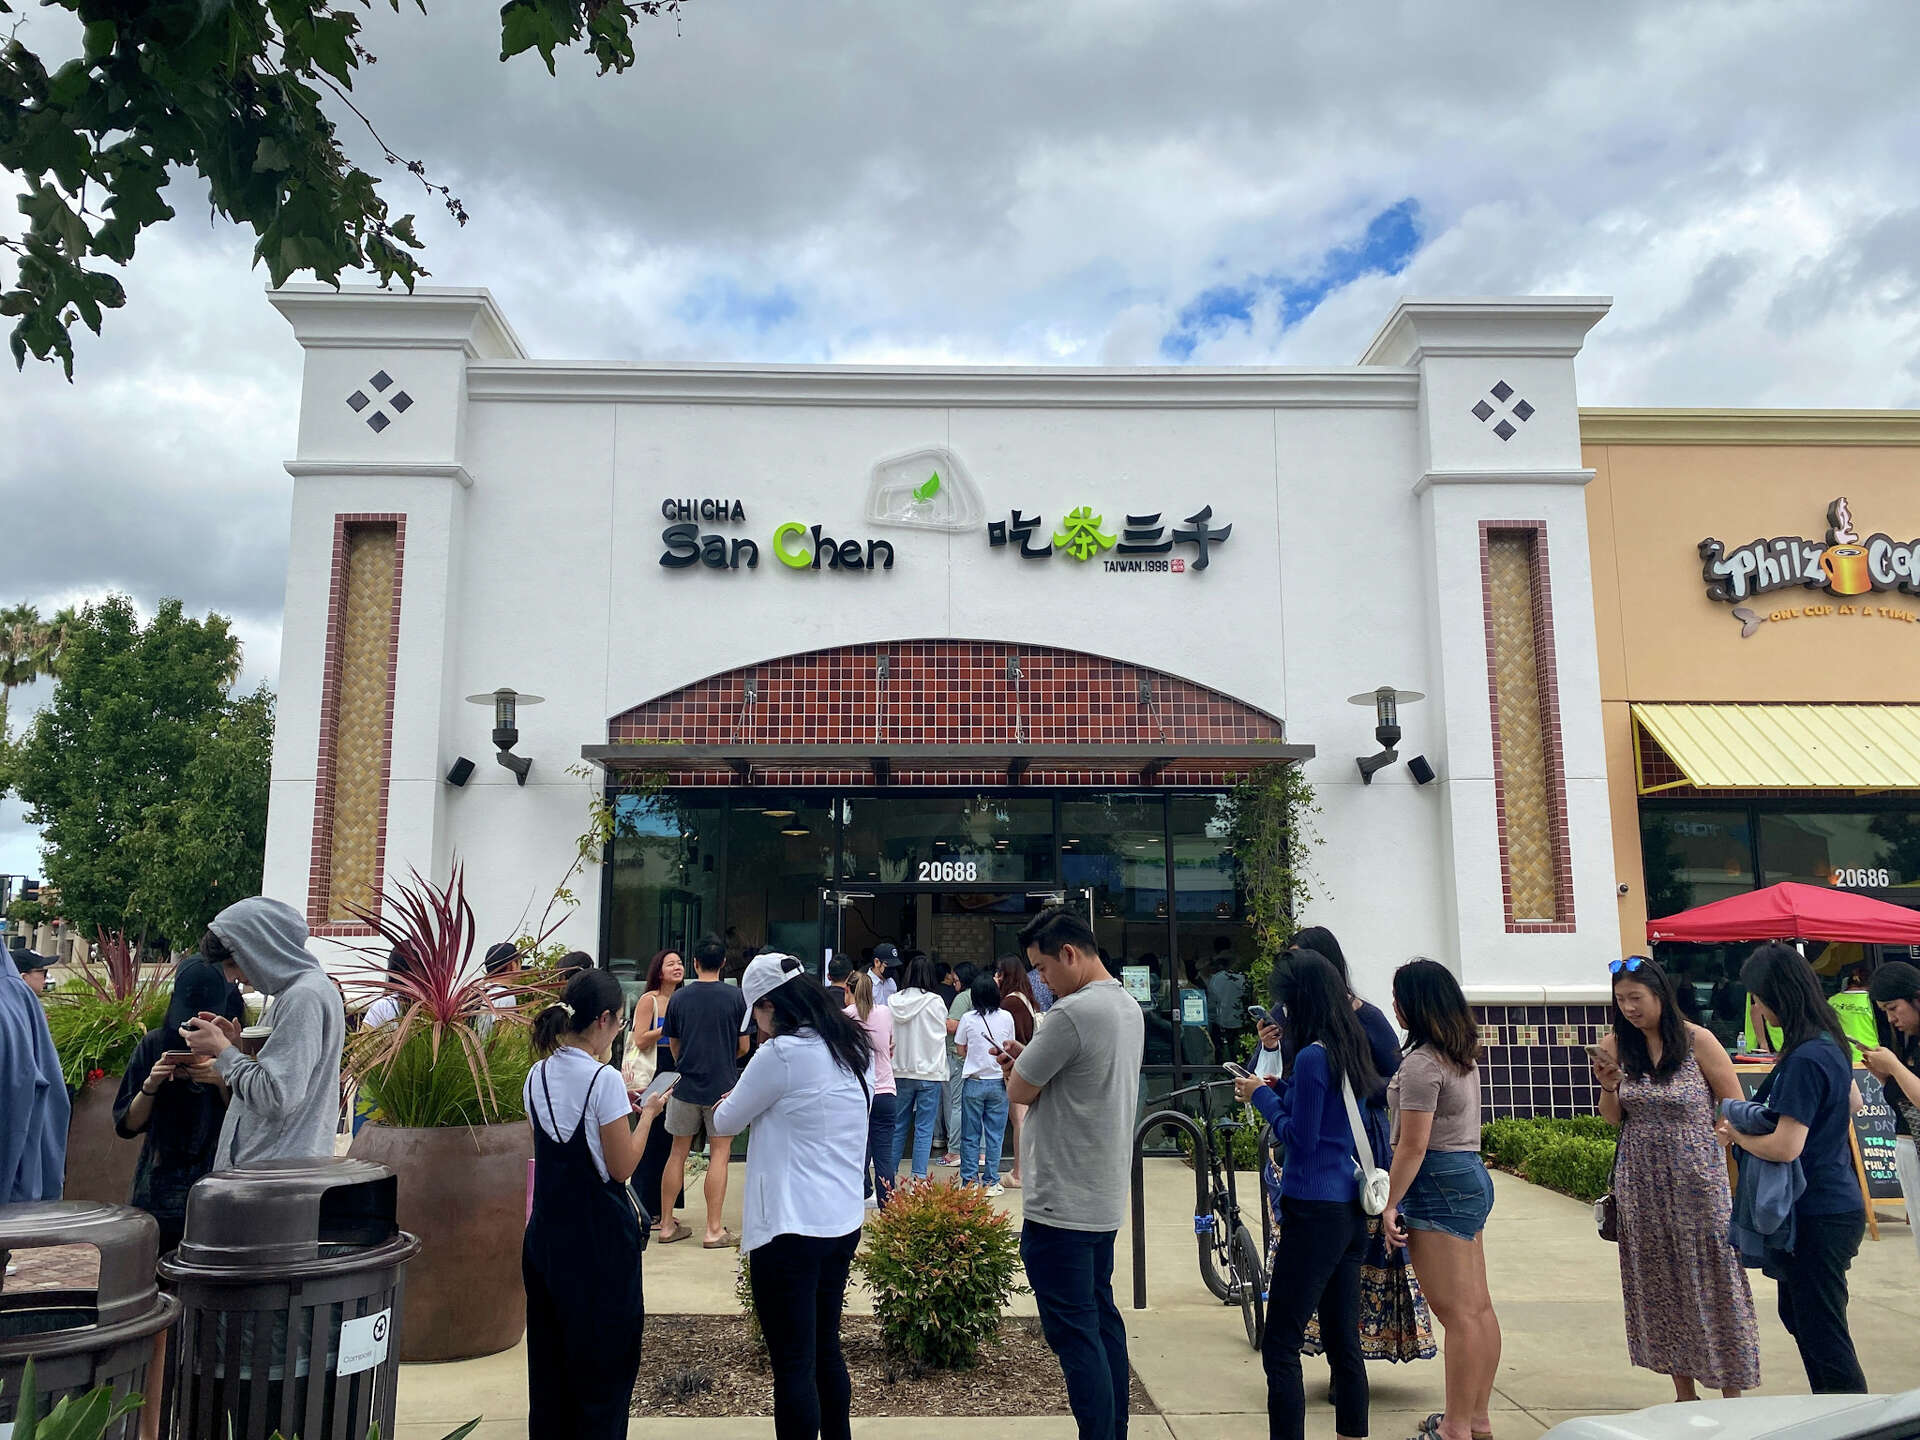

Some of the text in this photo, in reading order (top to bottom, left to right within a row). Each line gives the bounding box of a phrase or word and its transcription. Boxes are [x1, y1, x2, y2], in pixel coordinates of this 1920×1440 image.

[662, 498, 746, 521] CHICHA
[659, 521, 895, 570] San Chen
[987, 500, 1233, 571] 吃茶三千
[1103, 560, 1169, 573] TAIWAN.1998
[1704, 537, 1829, 600] Philz
[1770, 604, 1917, 623] ONE CUP AT A TIME
[918, 861, 977, 882] 20688
[1834, 868, 1890, 888] 20686
